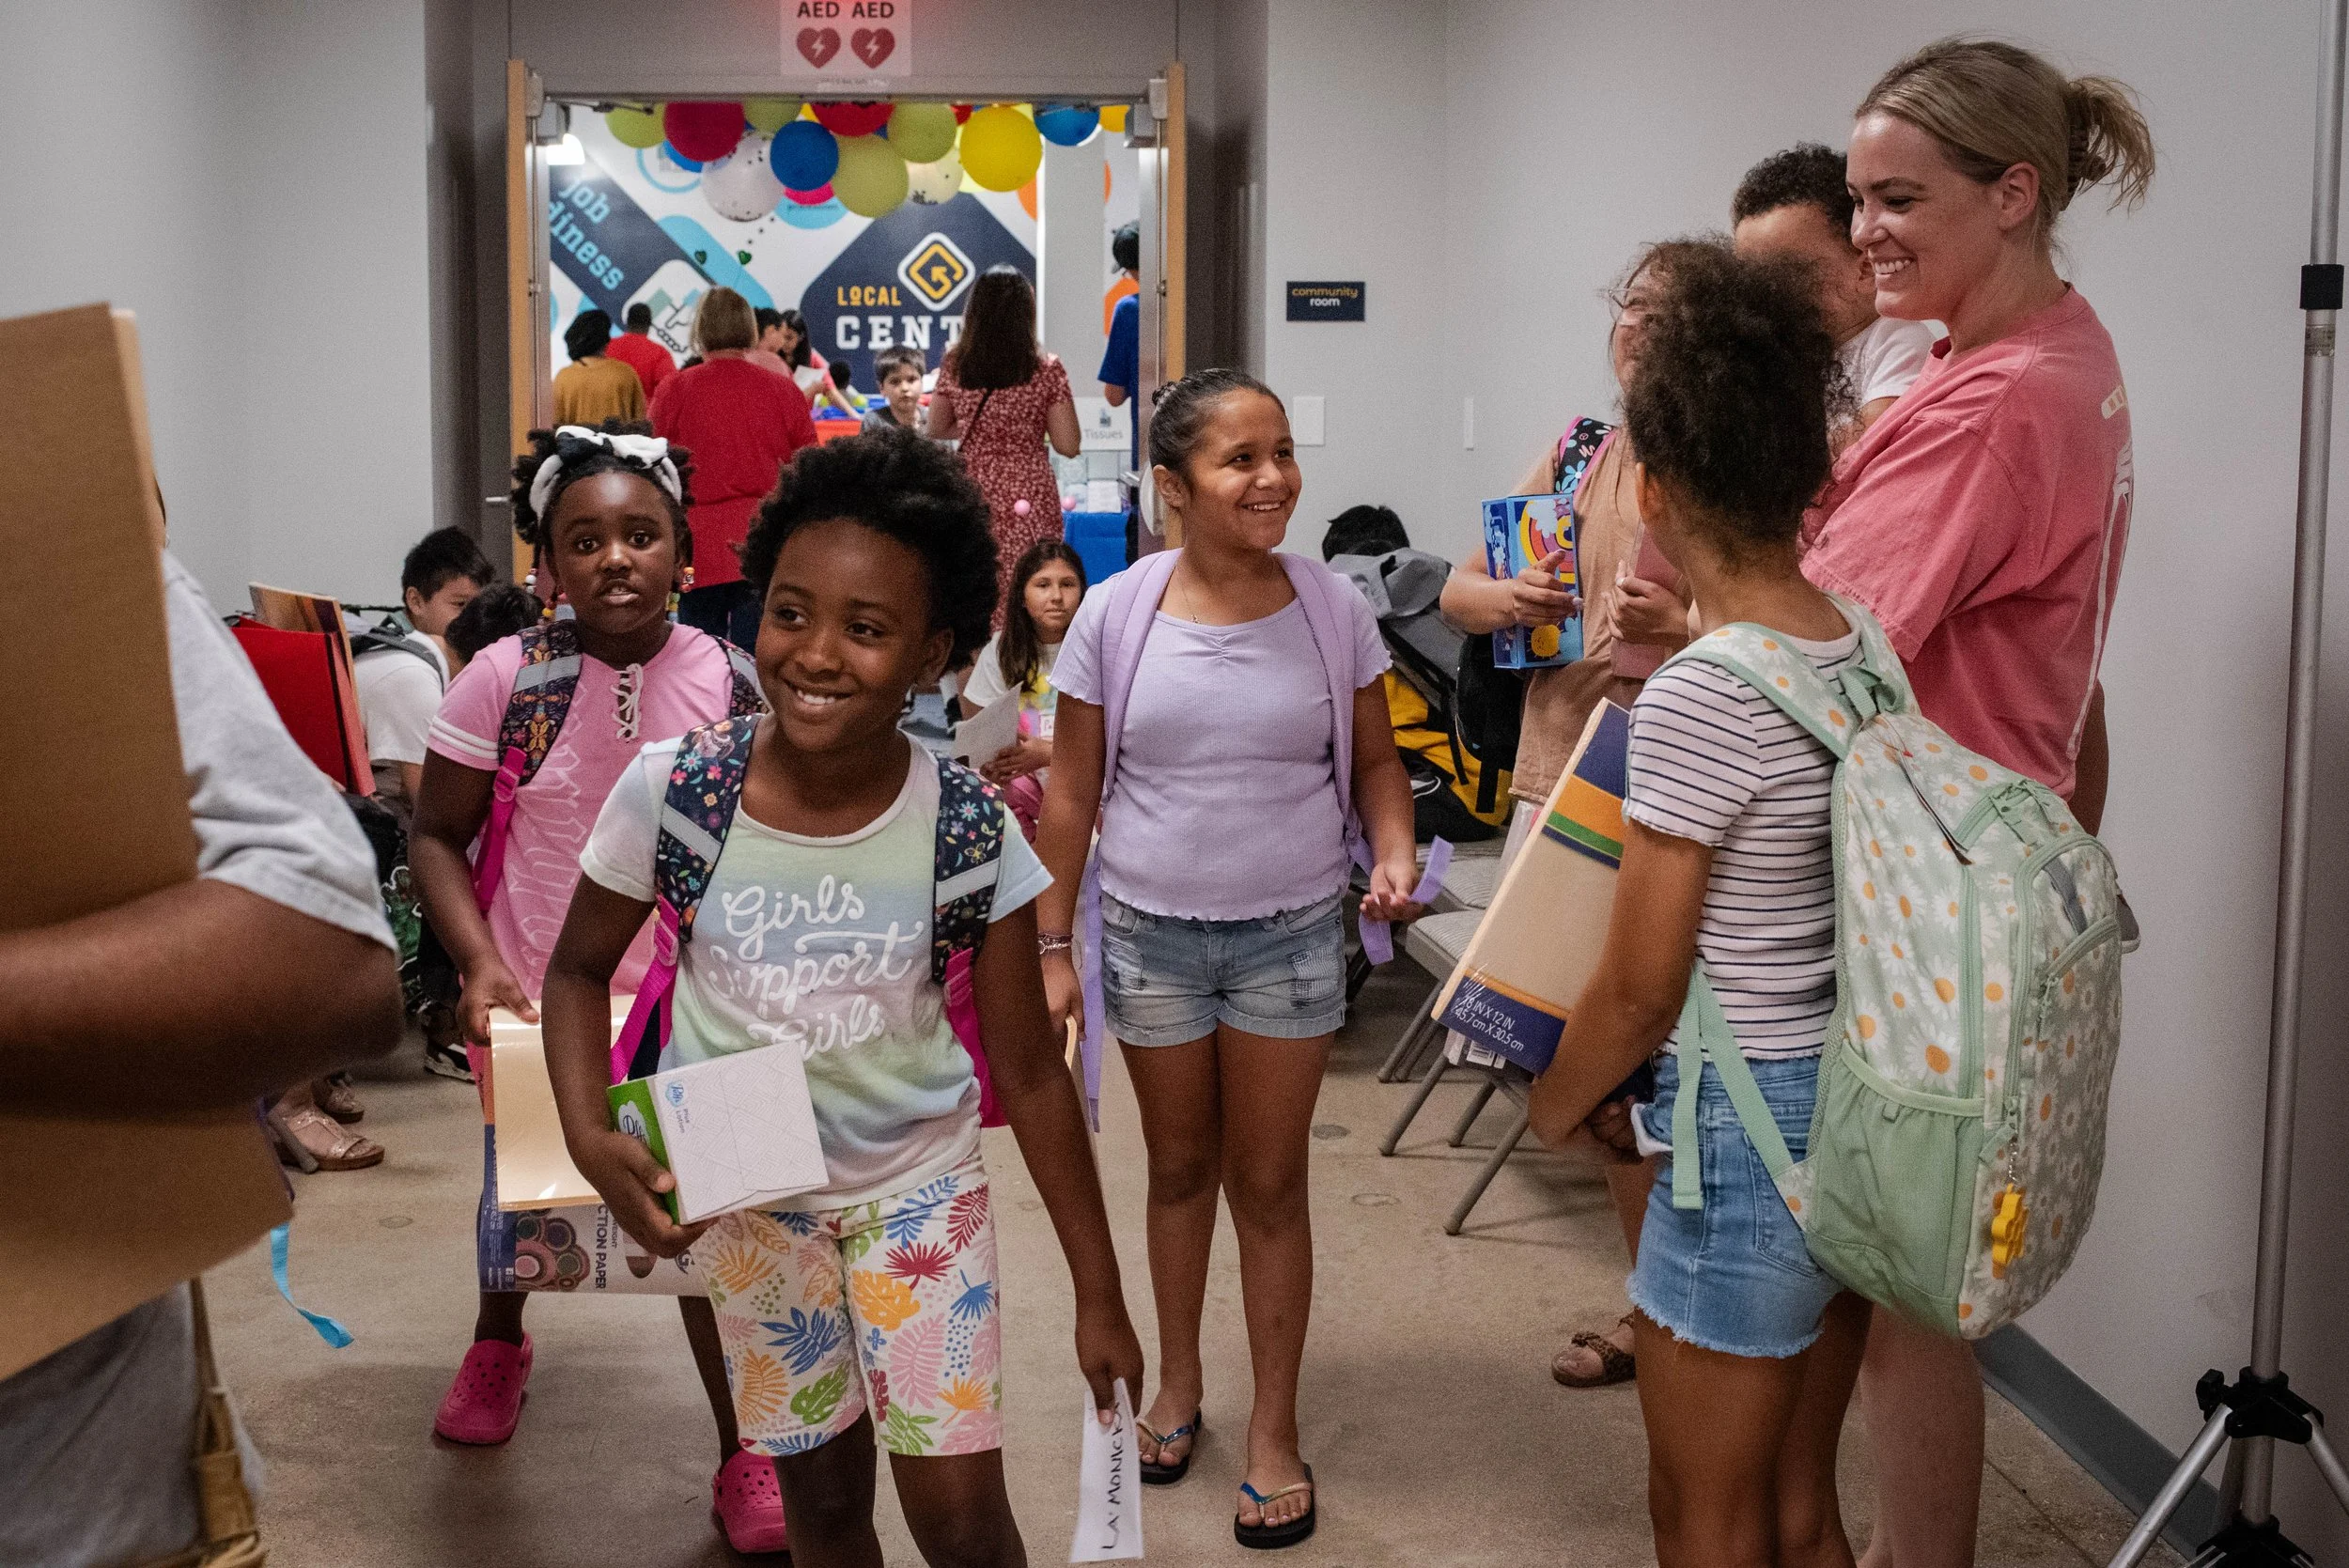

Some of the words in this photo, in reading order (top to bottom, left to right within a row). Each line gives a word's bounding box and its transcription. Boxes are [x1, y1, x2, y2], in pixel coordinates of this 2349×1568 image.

[797, 2, 840, 18] AED
[851, 2, 894, 18] AED
[558, 176, 611, 225] job
[836, 285, 902, 306] LOCAL
[1292, 287, 1359, 299] community
[1310, 298, 1340, 306] room
[1084, 428, 1124, 440] Tissues
[721, 874, 865, 961] Girls
[708, 920, 925, 1020] Support
[1455, 1006, 1475, 1024] 45.7
[1471, 1018, 1486, 1032] cm
[1485, 1023, 1496, 1036] X
[1492, 1027, 1514, 1045] 30.5
[1510, 1038, 1524, 1052] cm
[1492, 1010, 1504, 1025] 12
[1501, 1015, 1516, 1032] IN
[676, 1110, 685, 1134] Lotion
[595, 1251, 607, 1289] PAPER
